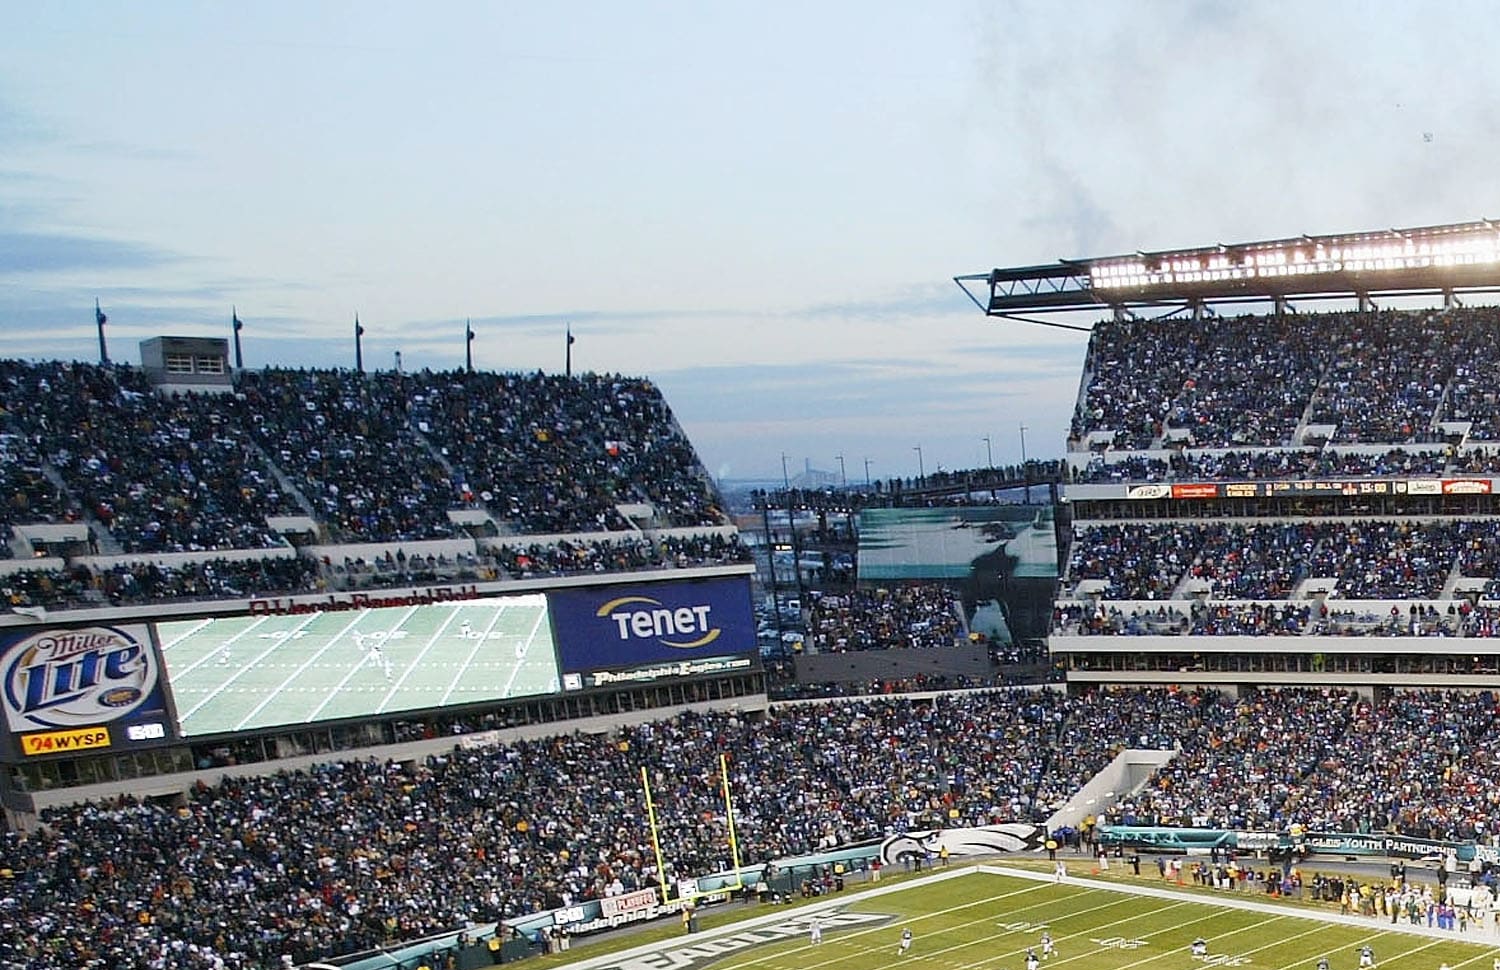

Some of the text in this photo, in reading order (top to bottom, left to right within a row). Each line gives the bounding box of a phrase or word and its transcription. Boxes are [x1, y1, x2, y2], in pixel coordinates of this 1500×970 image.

[38, 634, 114, 657] Miller
[21, 643, 143, 713] Lite
[55, 733, 106, 748] WYSP
